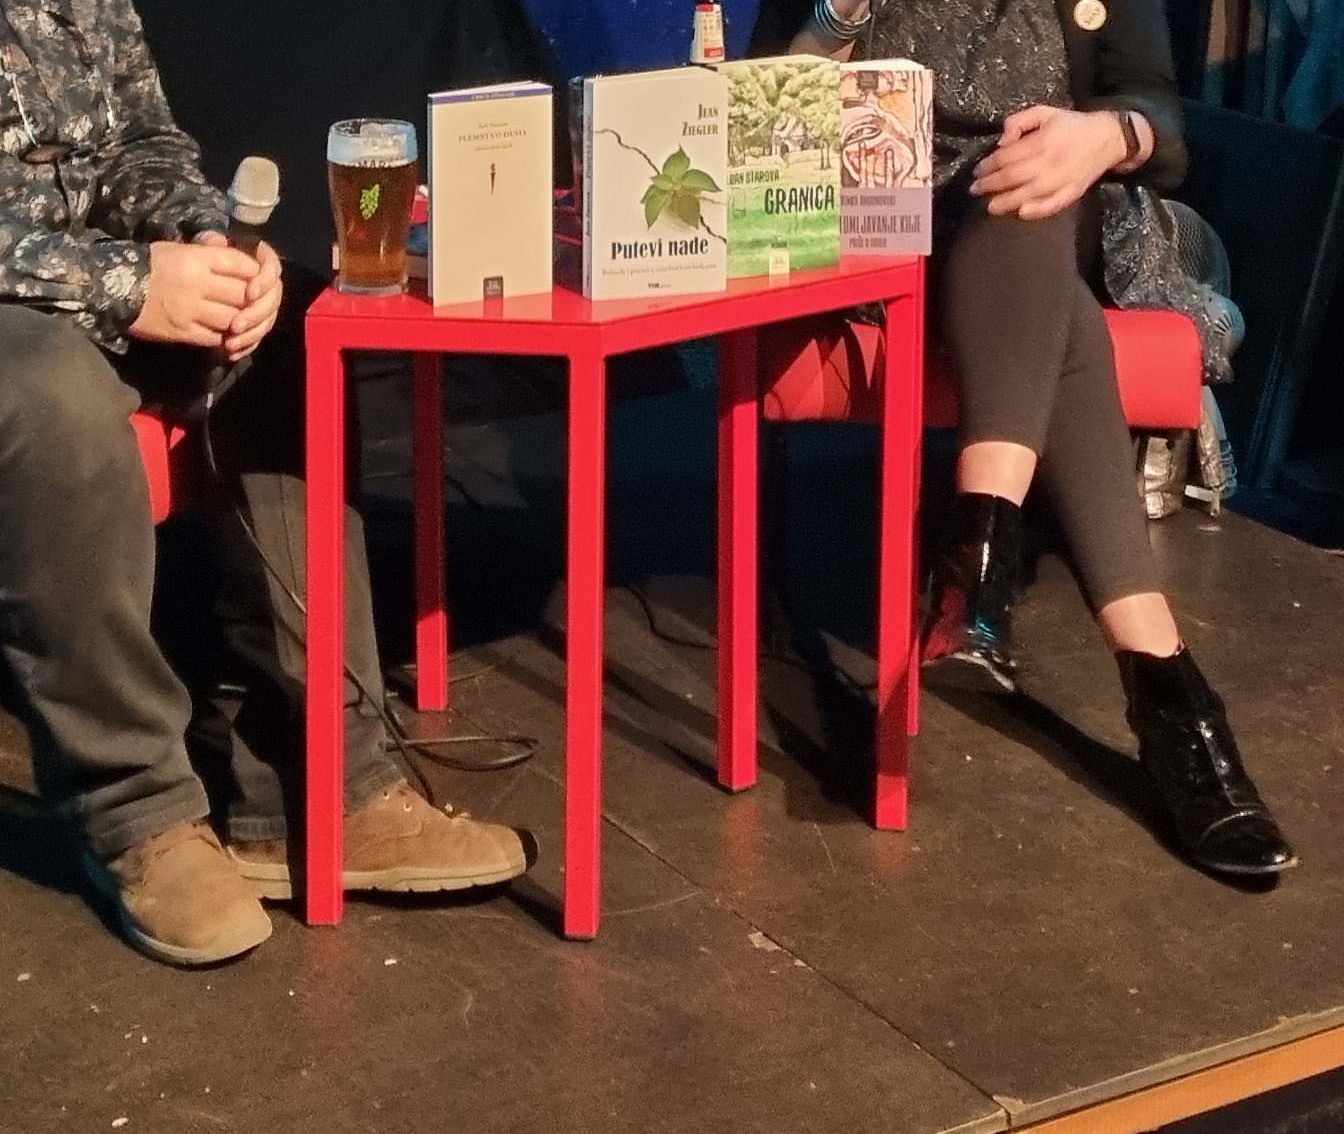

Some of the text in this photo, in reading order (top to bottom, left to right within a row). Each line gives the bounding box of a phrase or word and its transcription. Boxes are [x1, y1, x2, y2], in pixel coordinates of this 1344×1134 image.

[698, 104, 719, 120] JEAN
[682, 122, 718, 136] ZIEGLER
[727, 169, 780, 185] UAN STAROVA
[764, 185, 834, 215] GRANICA
[900, 215, 921, 234] KUJE
[611, 236, 709, 261] Putevi nade
